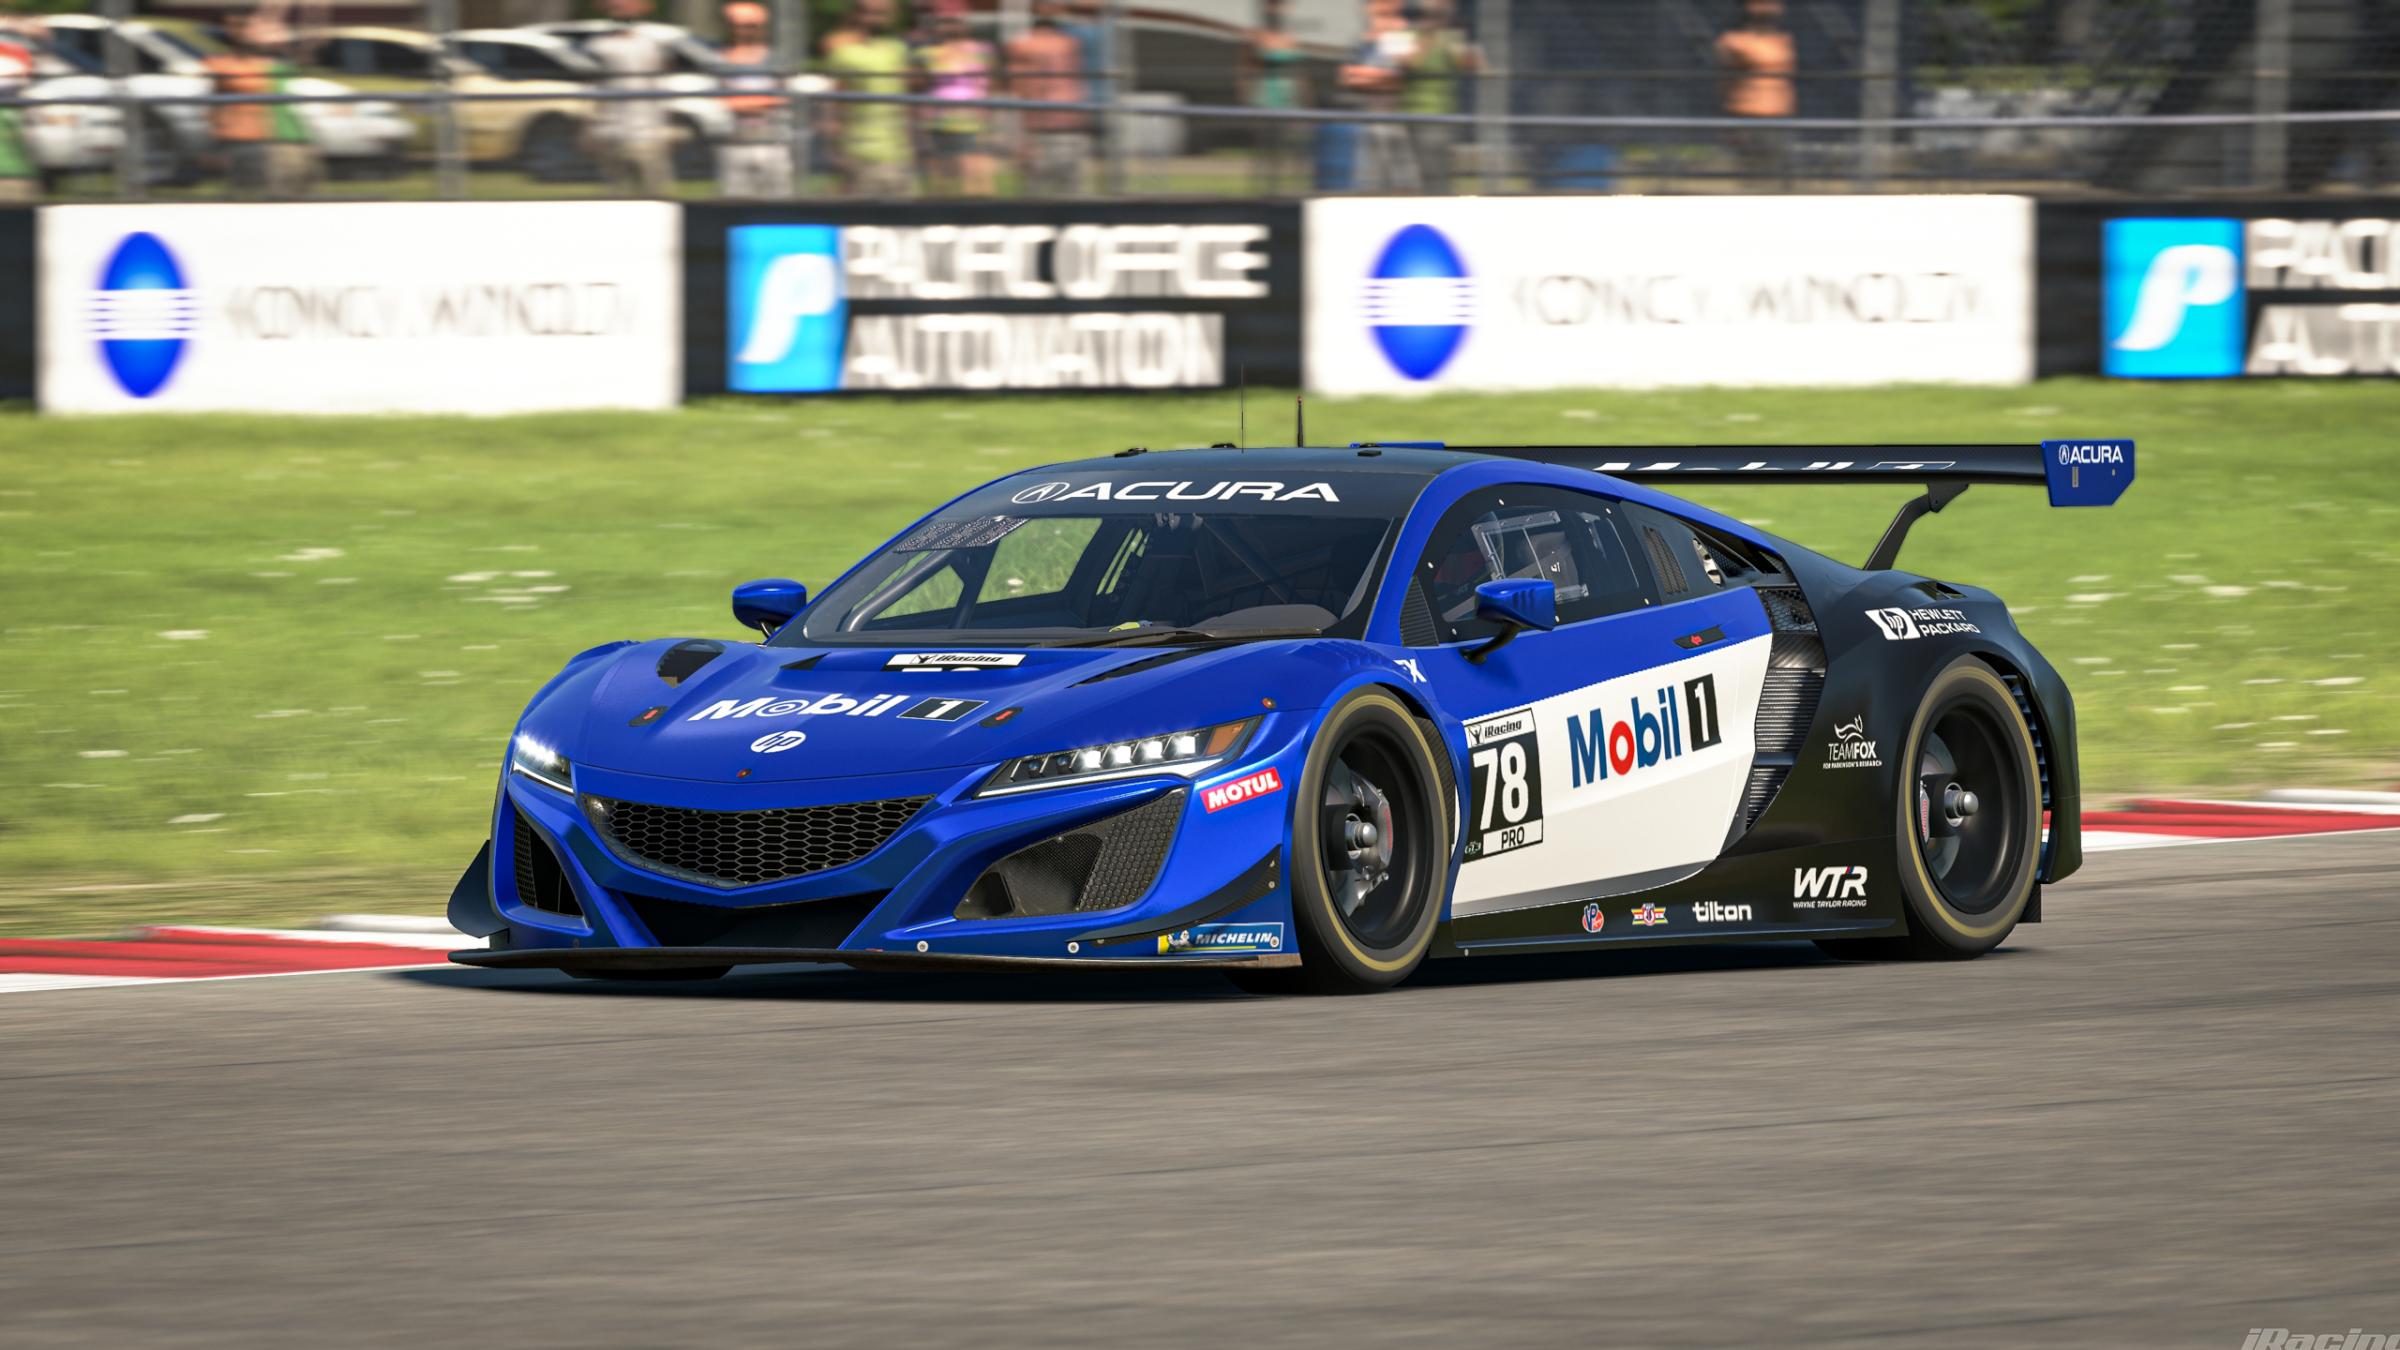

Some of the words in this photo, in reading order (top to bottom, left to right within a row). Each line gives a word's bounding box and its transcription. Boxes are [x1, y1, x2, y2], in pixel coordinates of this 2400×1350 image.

[1054, 223, 1270, 298] OFFCE
[842, 312, 1225, 388] AUTOMATON
[2069, 445, 2124, 464] ACURA
[1062, 481, 1340, 503] ACURA
[1908, 608, 1967, 621] HEWLETT
[1919, 622, 1981, 637] PACKARD
[687, 693, 911, 722] Mobil
[925, 699, 959, 719] 1
[1484, 720, 1522, 738] iRacing
[1567, 685, 1683, 789] Mobil
[1694, 681, 1711, 744] 1
[1208, 771, 1278, 810] MOTUL
[1472, 742, 1530, 831] 78
[1501, 826, 1525, 849] PRO
[1794, 866, 1868, 899] WTR
[1692, 901, 1753, 923] tilton
[1793, 901, 1815, 909] WAYNE
[1817, 900, 1841, 908] TAYLOR
[1842, 899, 1868, 908] RACING
[1196, 931, 1271, 945] MICHELIN
